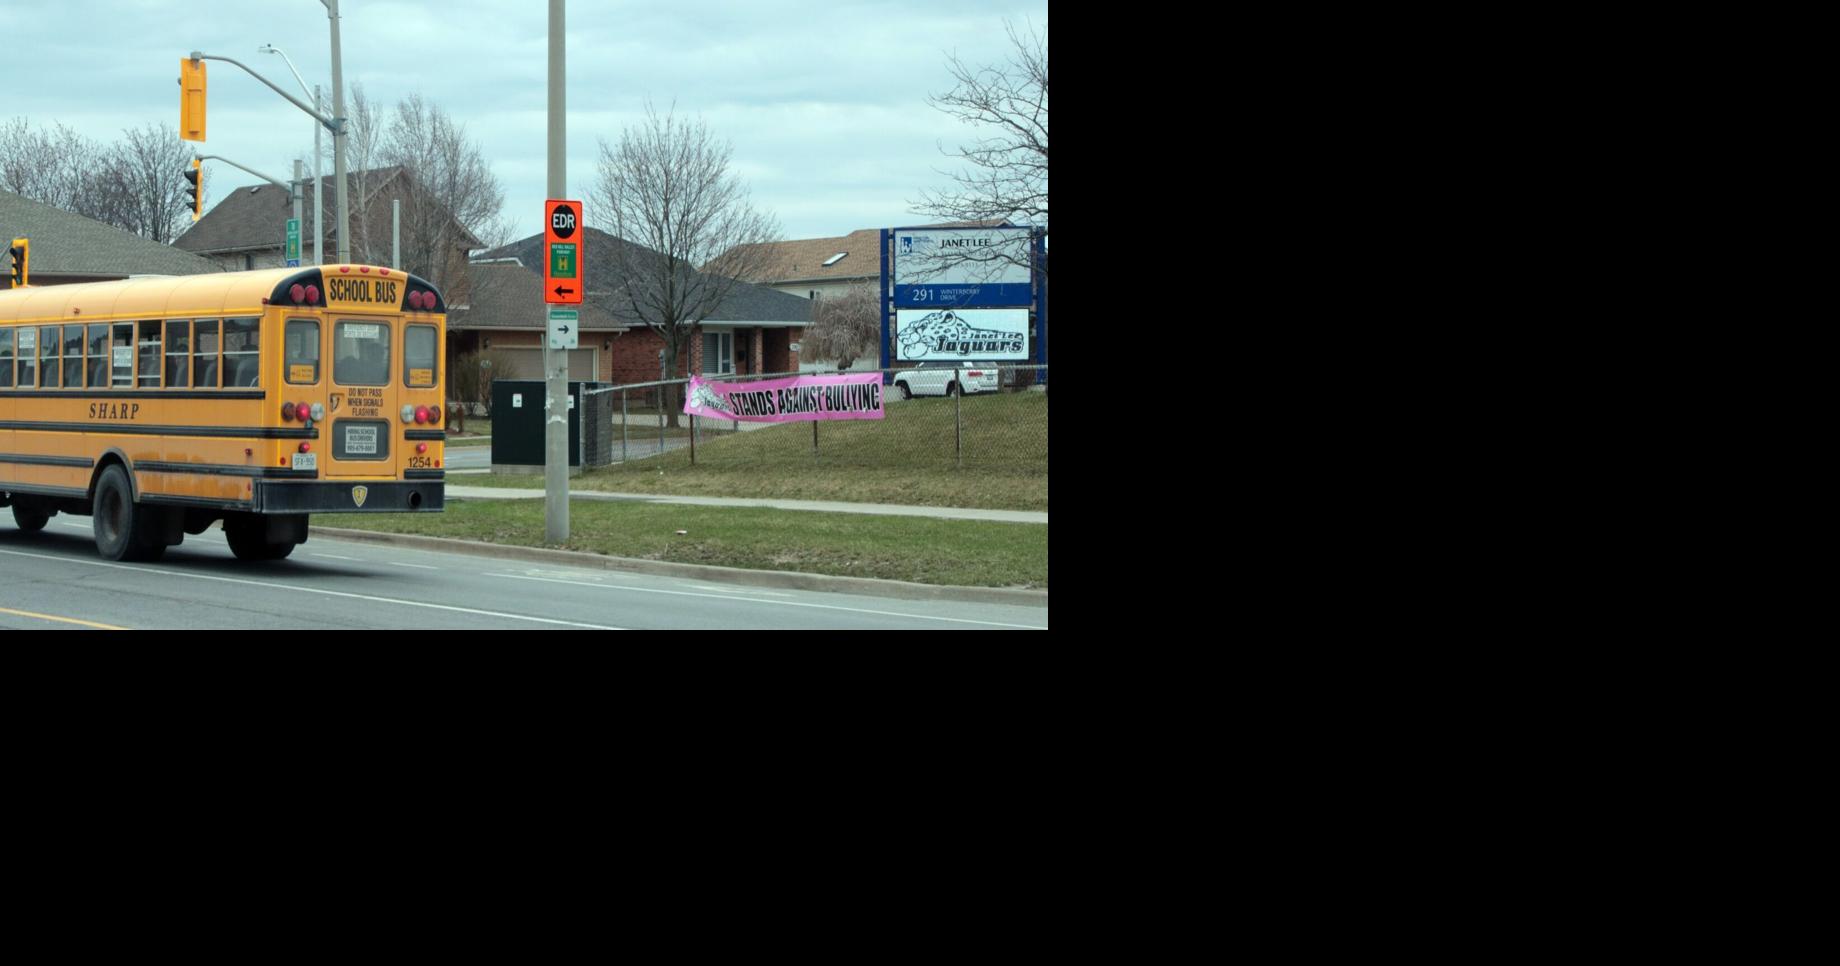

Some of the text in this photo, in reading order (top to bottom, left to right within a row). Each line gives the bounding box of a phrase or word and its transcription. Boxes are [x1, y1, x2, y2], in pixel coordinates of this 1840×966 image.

[552, 213, 575, 229] EDR
[940, 239, 970, 249] JANET
[973, 239, 991, 247] LEE
[330, 278, 397, 304] SCHOOL BUS
[912, 289, 934, 301] 291
[934, 336, 1023, 356] Jaguars
[348, 388, 383, 398] DO NOT PASS
[348, 398, 384, 408] WHEN SIGNALS
[729, 383, 880, 416] STANDS AGAINST BULLYING
[89, 402, 140, 420] SHARP
[352, 407, 379, 417] FLASHING
[408, 457, 431, 468] 1254
